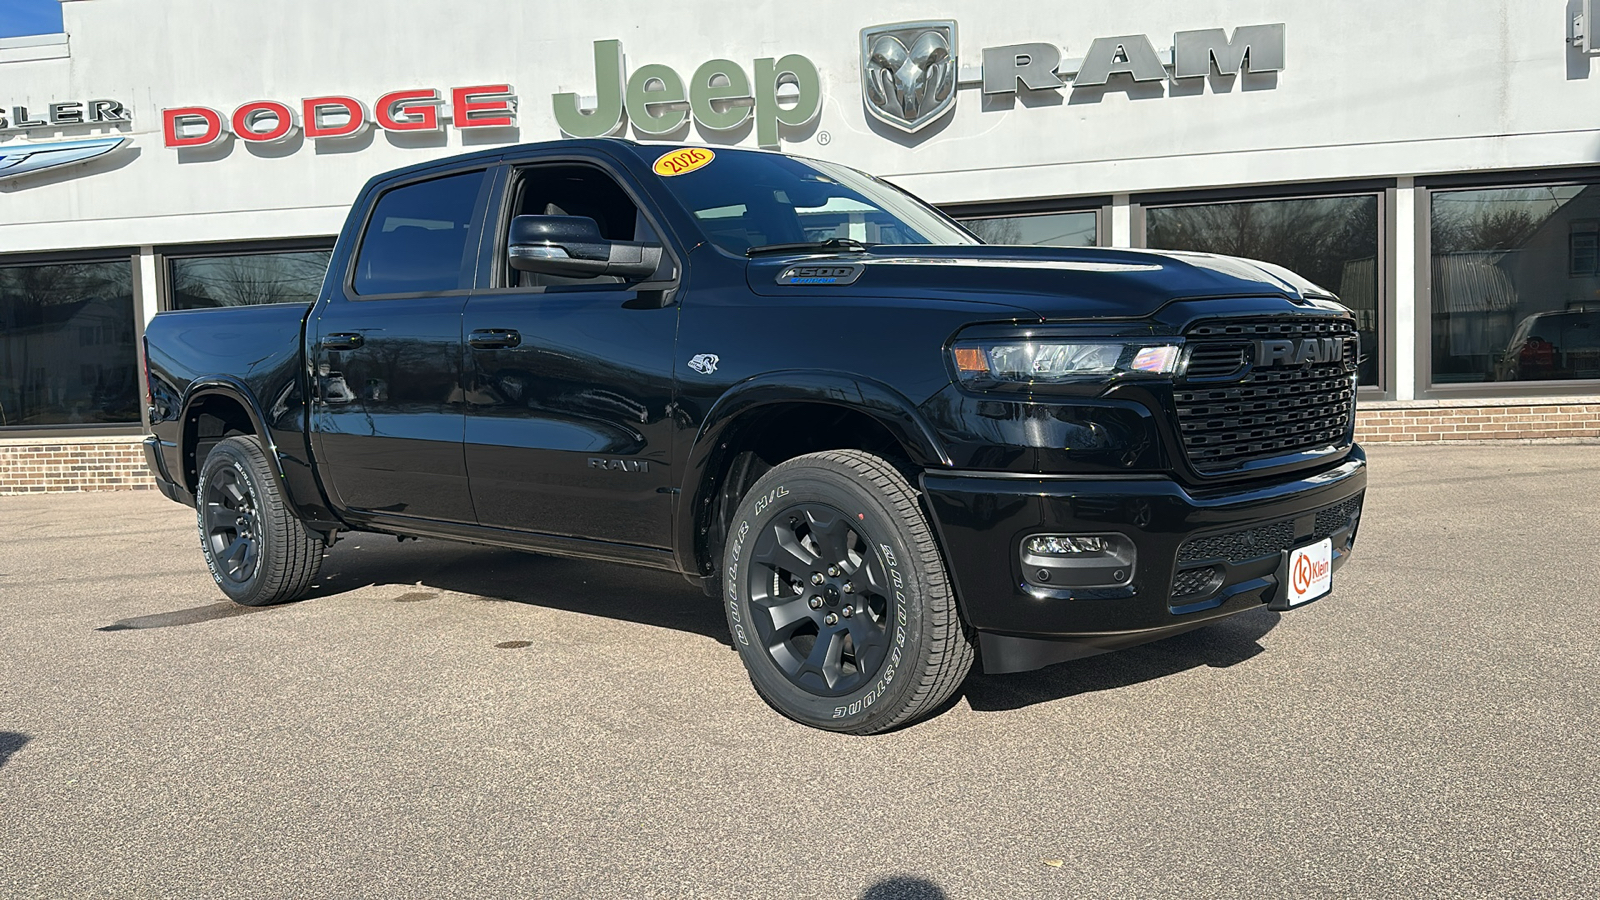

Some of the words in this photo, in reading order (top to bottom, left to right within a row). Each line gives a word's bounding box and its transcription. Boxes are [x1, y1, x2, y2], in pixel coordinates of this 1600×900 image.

[981, 23, 1286, 95] RAM
[551, 39, 821, 147] Jeep
[0, 99, 122, 128] LER
[162, 84, 514, 148] DODGE
[663, 149, 706, 173] 2026
[1260, 337, 1343, 367] RAM
[587, 457, 650, 473] RAM
[1312, 559, 1329, 580] Klein
[832, 543, 908, 719] BRIDGESTONE
